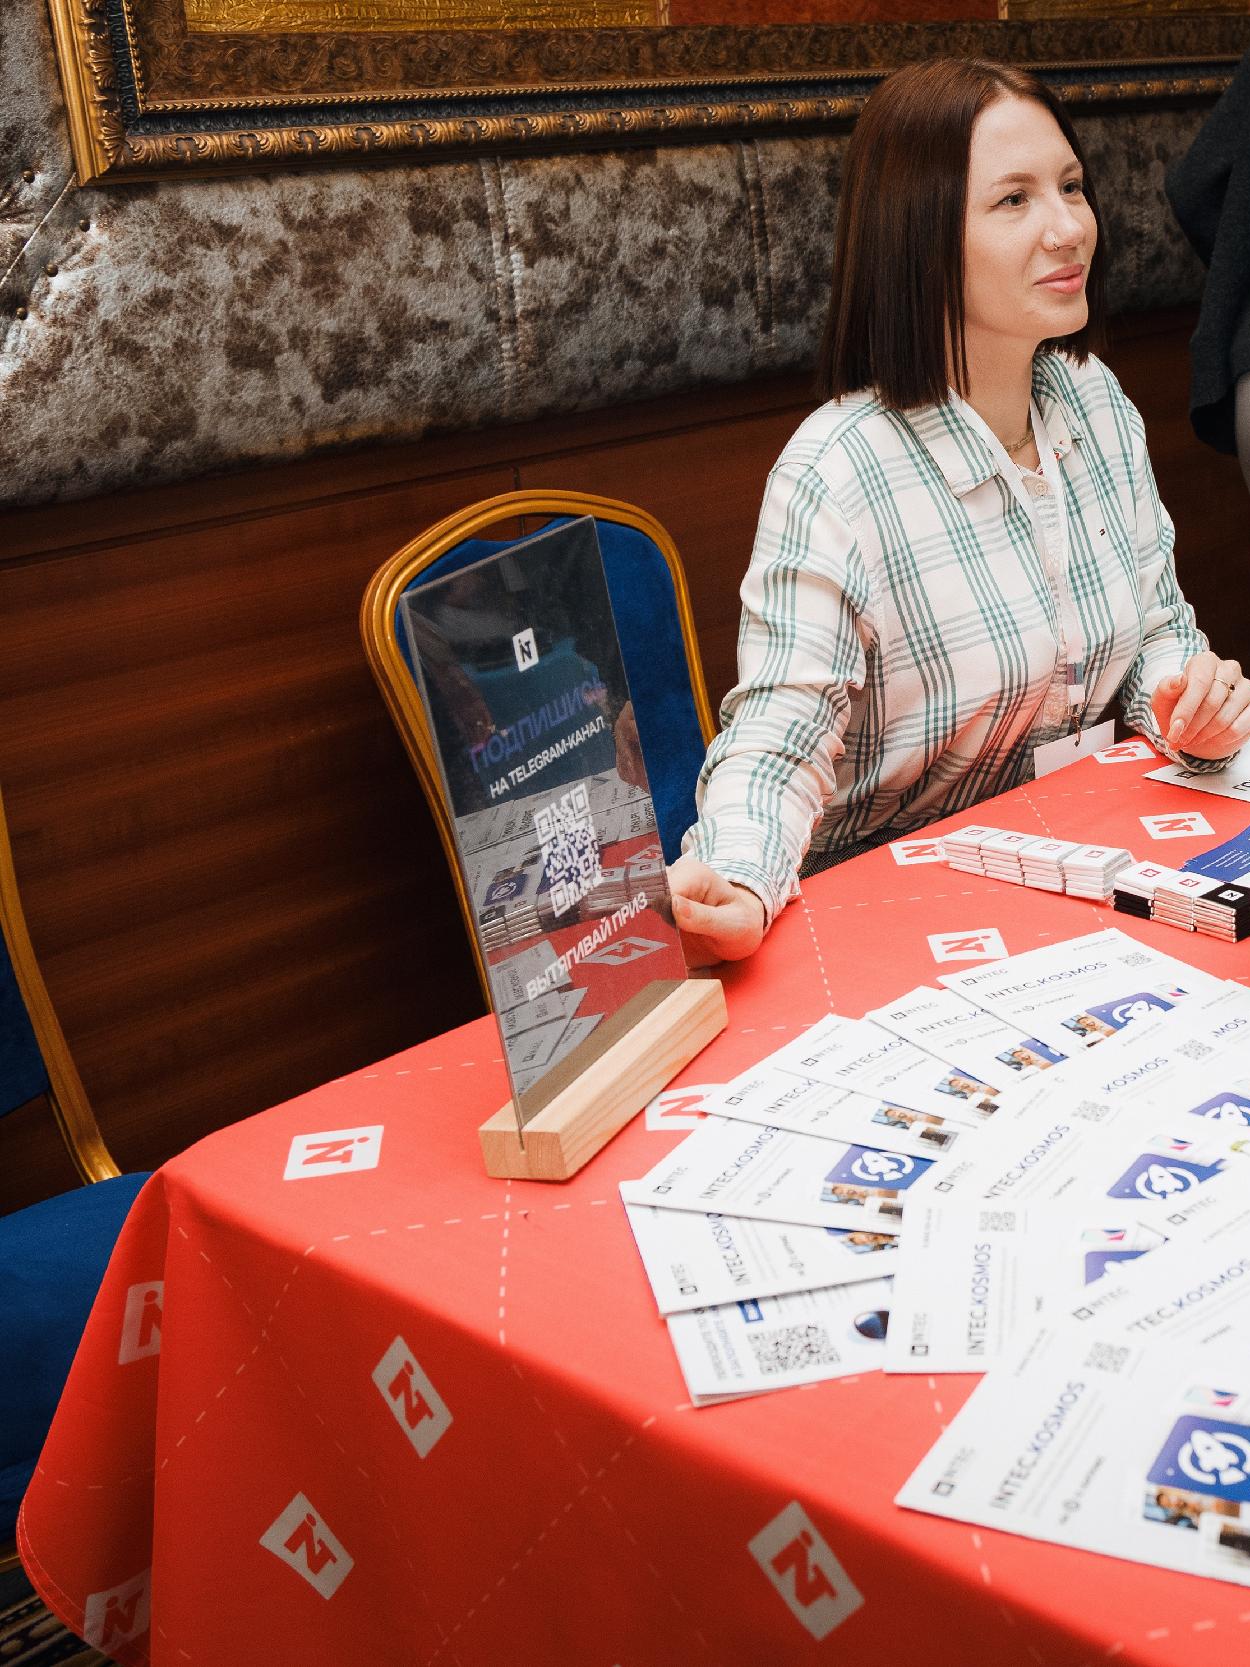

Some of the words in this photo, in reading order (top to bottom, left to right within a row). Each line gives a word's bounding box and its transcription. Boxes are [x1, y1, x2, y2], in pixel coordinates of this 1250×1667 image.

[489, 776, 511, 799] НА
[525, 915, 611, 1001] ВЫТЯГИВАЙ
[611, 890, 649, 934] ПРИЗ
